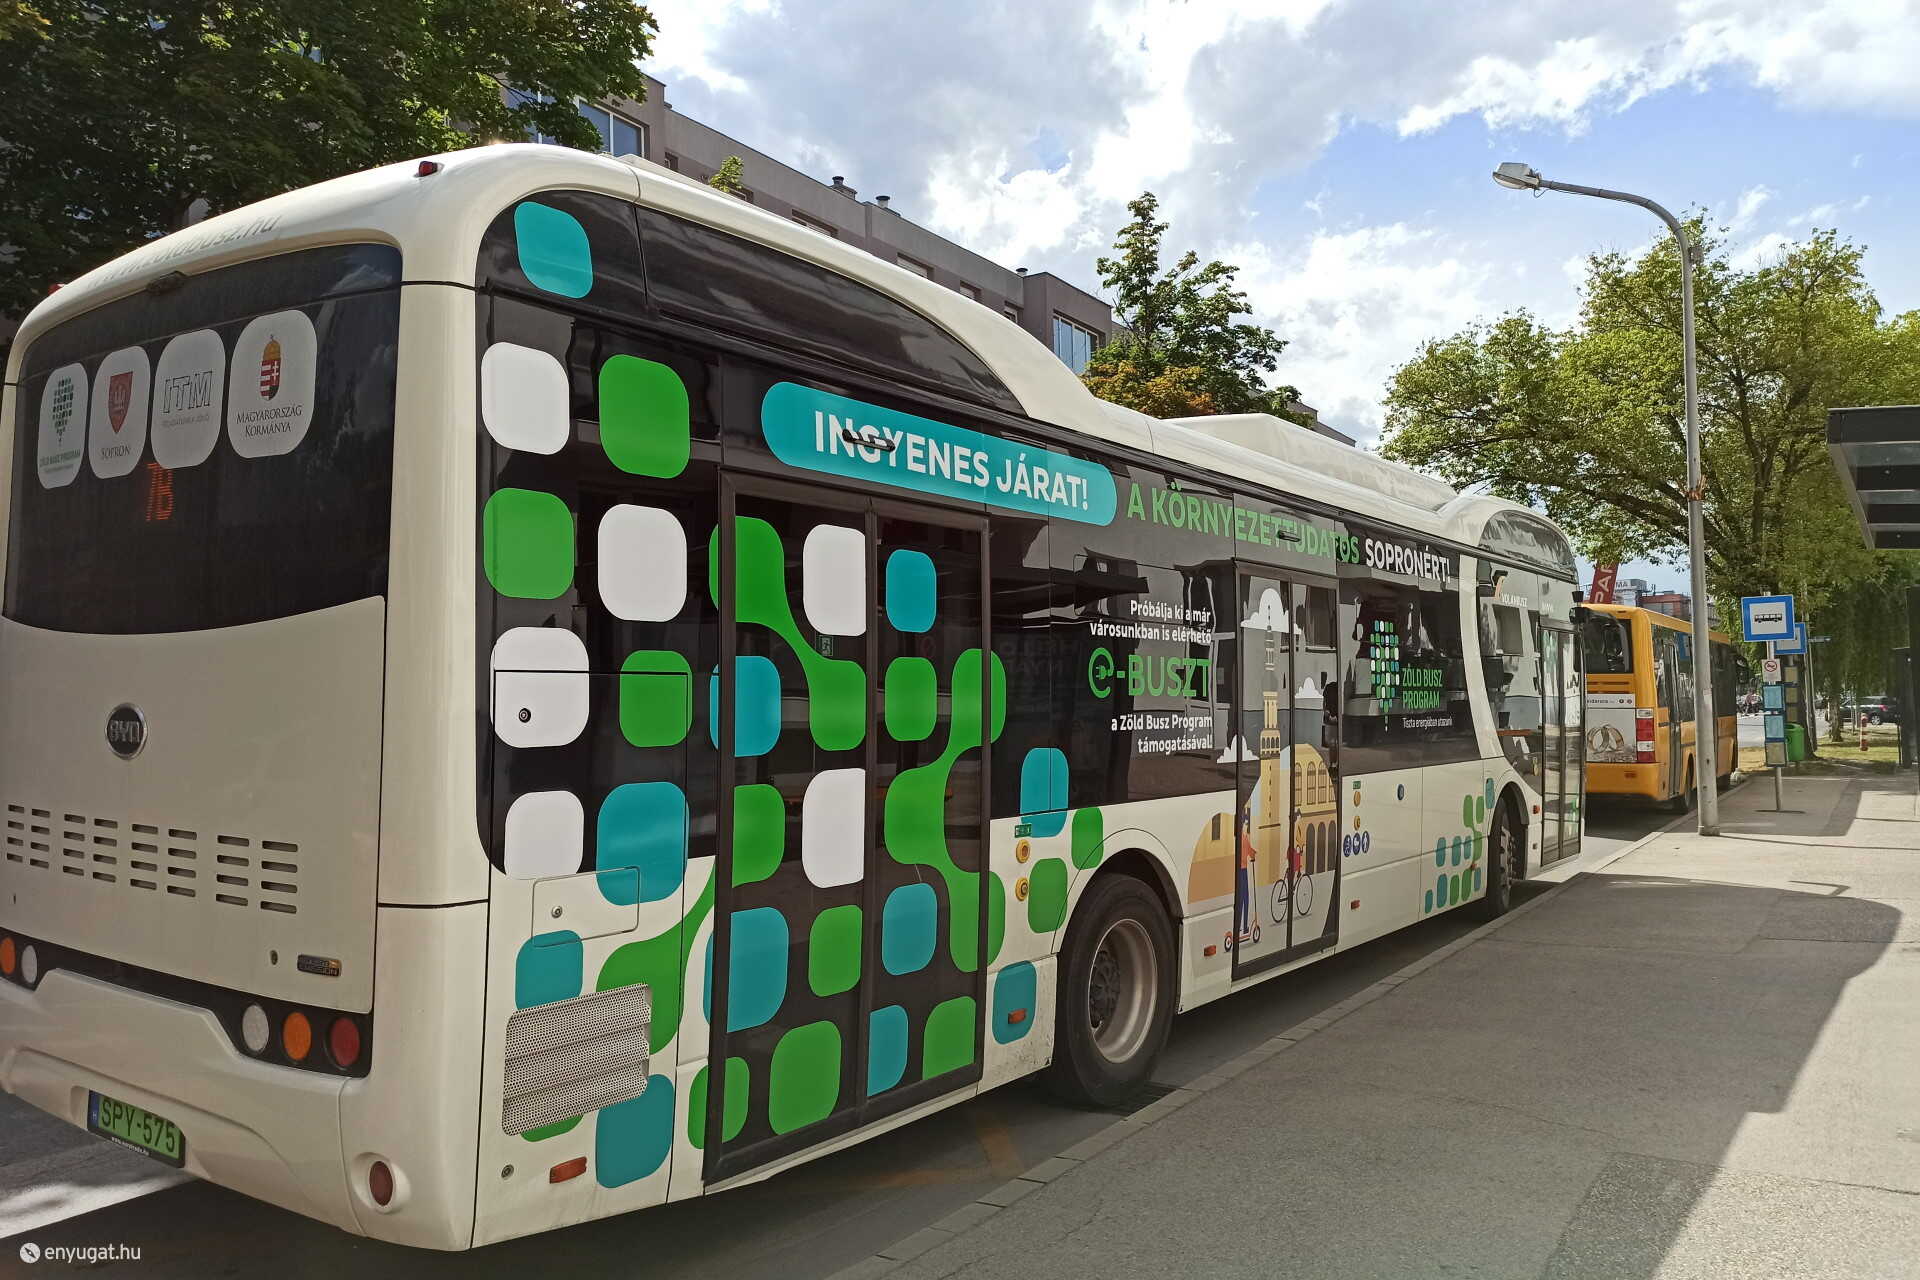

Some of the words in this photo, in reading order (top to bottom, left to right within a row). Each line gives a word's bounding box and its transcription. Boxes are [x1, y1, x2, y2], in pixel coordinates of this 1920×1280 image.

[162, 370, 213, 414] ITM
[236, 404, 303, 425] MAGYARORSZÁG
[244, 421, 292, 437] KORMÁNYA
[814, 410, 990, 488] INGYENES
[995, 452, 1089, 511] JÁRAT!
[1127, 482, 1146, 521] A
[1151, 481, 1361, 564] KÖRNYEZETTUDATOS
[1365, 537, 1451, 583] SOPRONÉRT!
[1130, 599, 1173, 622] Próbálja
[1174, 604, 1184, 620] ki
[1185, 609, 1191, 621] a
[1192, 607, 1212, 623] már
[1089, 618, 1160, 640] városunkban
[1161, 624, 1170, 641] is
[1171, 626, 1212, 643] elérhető
[1423, 668, 1443, 688] BUSZ
[1402, 690, 1440, 709] PROGRAM
[1111, 718, 1118, 731] a
[1119, 713, 1144, 731] Zöld
[1146, 714, 1170, 730] Busz
[1171, 714, 1213, 731] Program
[1137, 734, 1213, 755] támogatásával!
[101, 1099, 175, 1153] SPY-575
